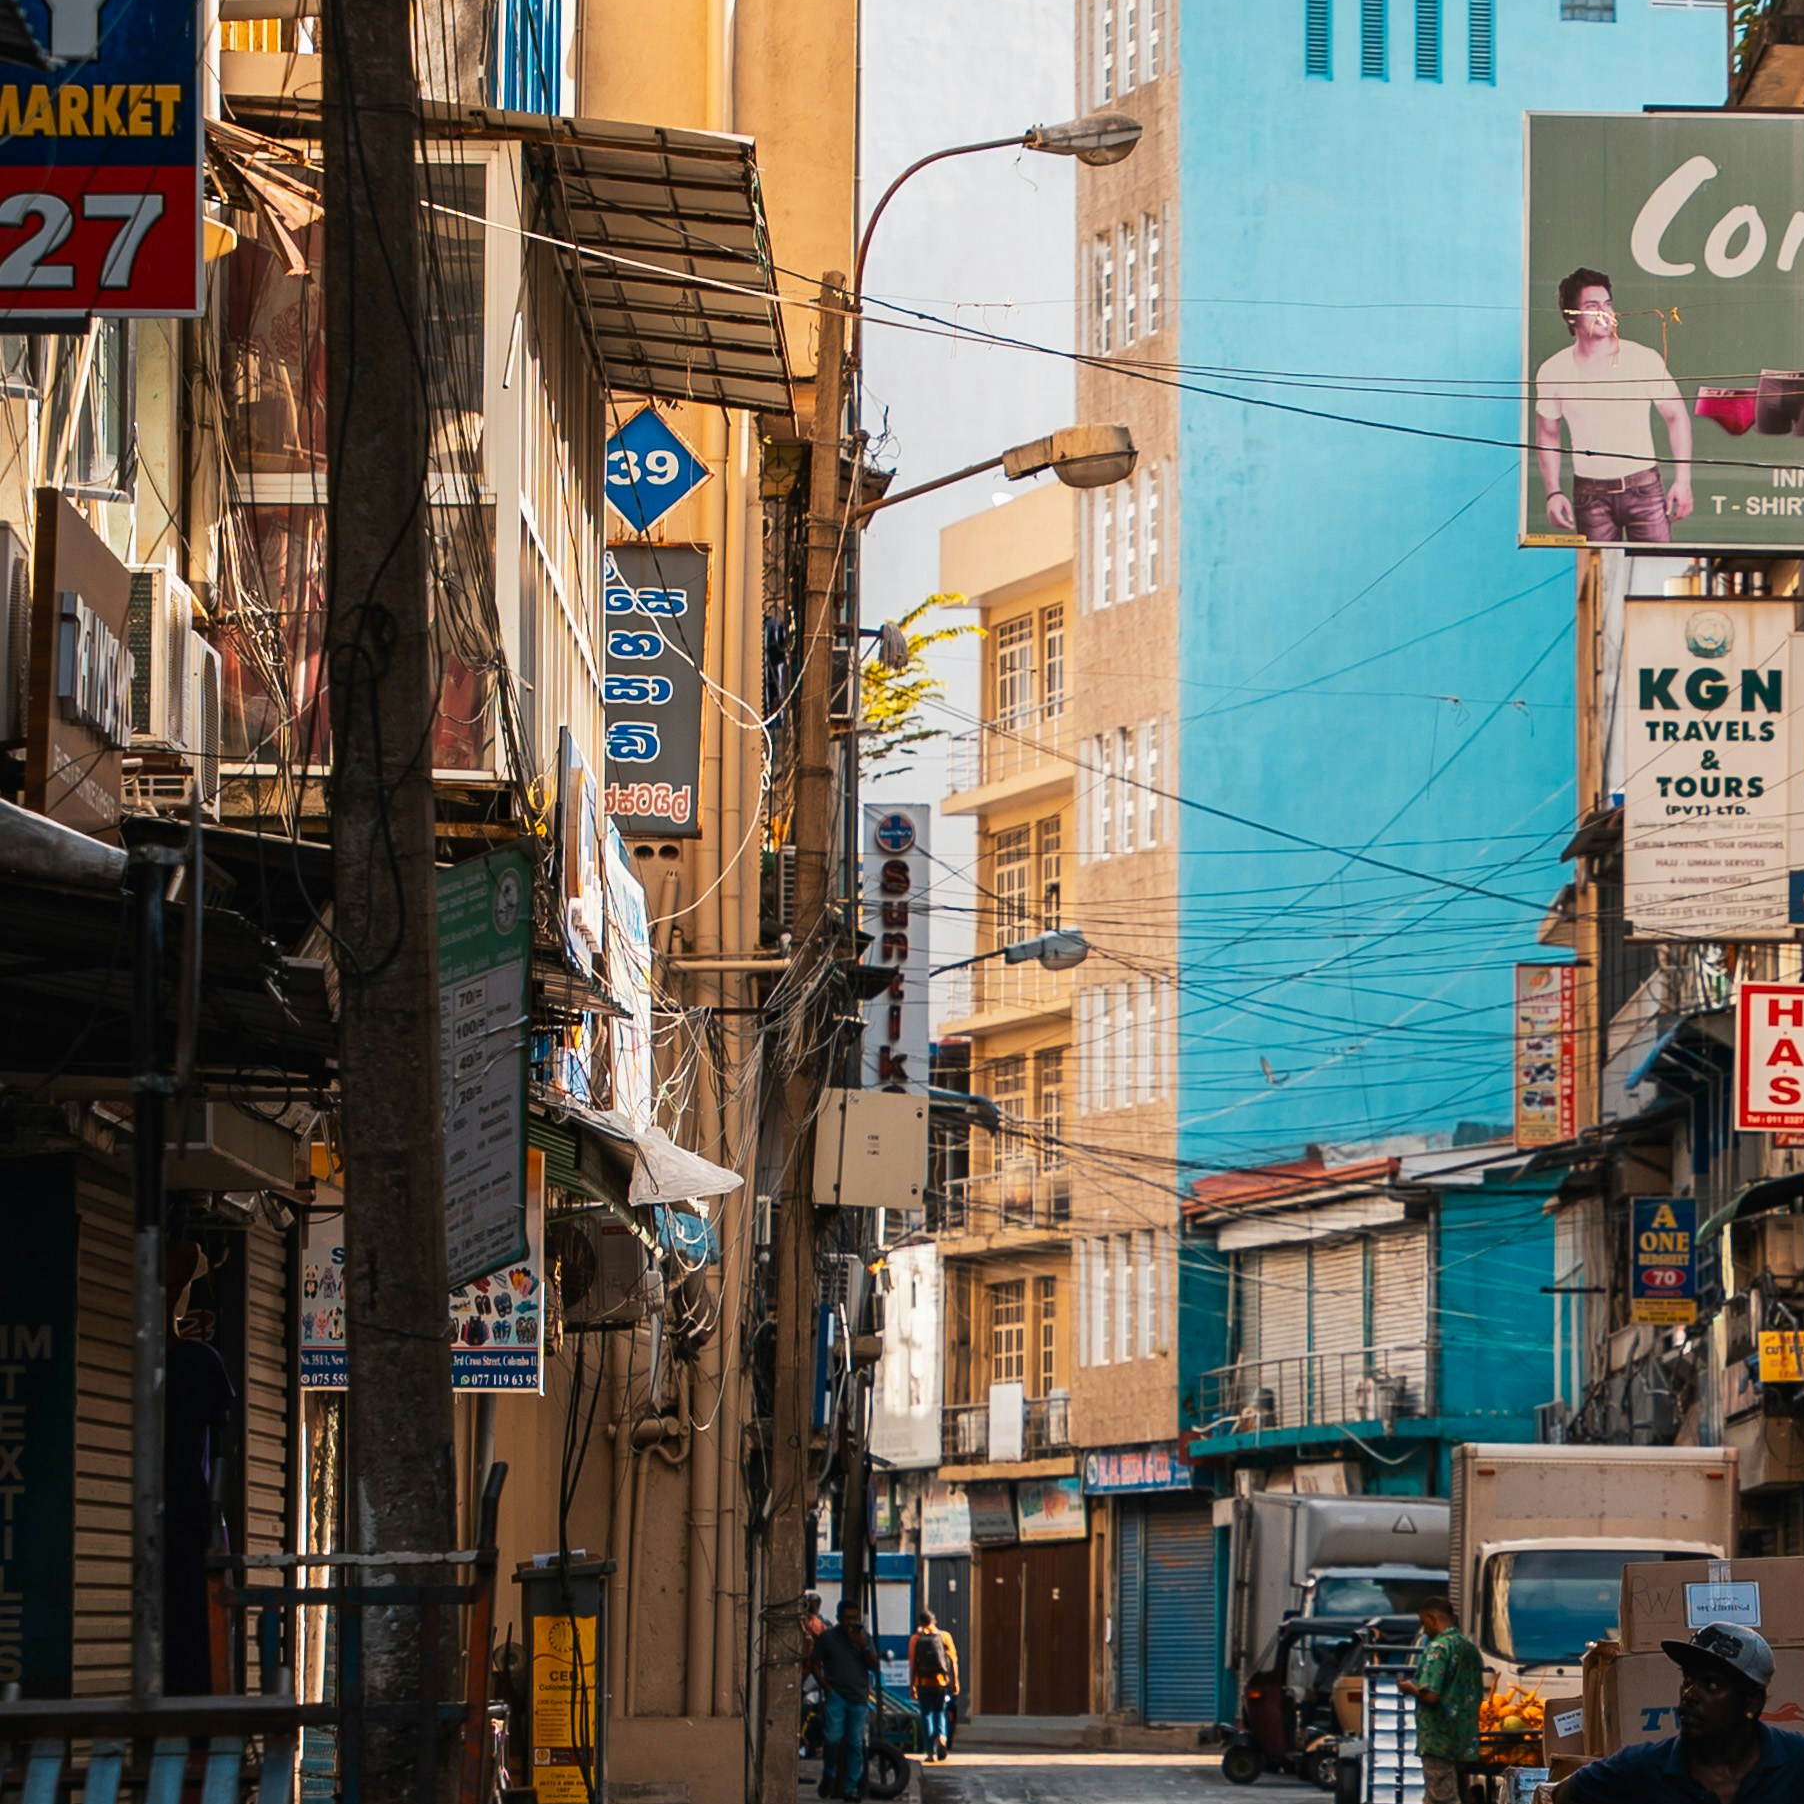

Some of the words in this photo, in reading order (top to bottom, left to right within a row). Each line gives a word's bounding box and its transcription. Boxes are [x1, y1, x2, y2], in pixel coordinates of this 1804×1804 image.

[607, 449, 681, 486] 39
[1637, 667, 1784, 713] KGN
[1645, 720, 1776, 742] TRAVELS
[1700, 749, 1721, 772] &
[1656, 776, 1764, 799] TOURS
[1724, 859, 1766, 868] SERVICES
[1651, 1203, 1678, 1229] A
[1639, 1231, 1690, 1253] ONE
[1653, 1269, 1677, 1286] 70
[471, 1374, 490, 1386] 077
